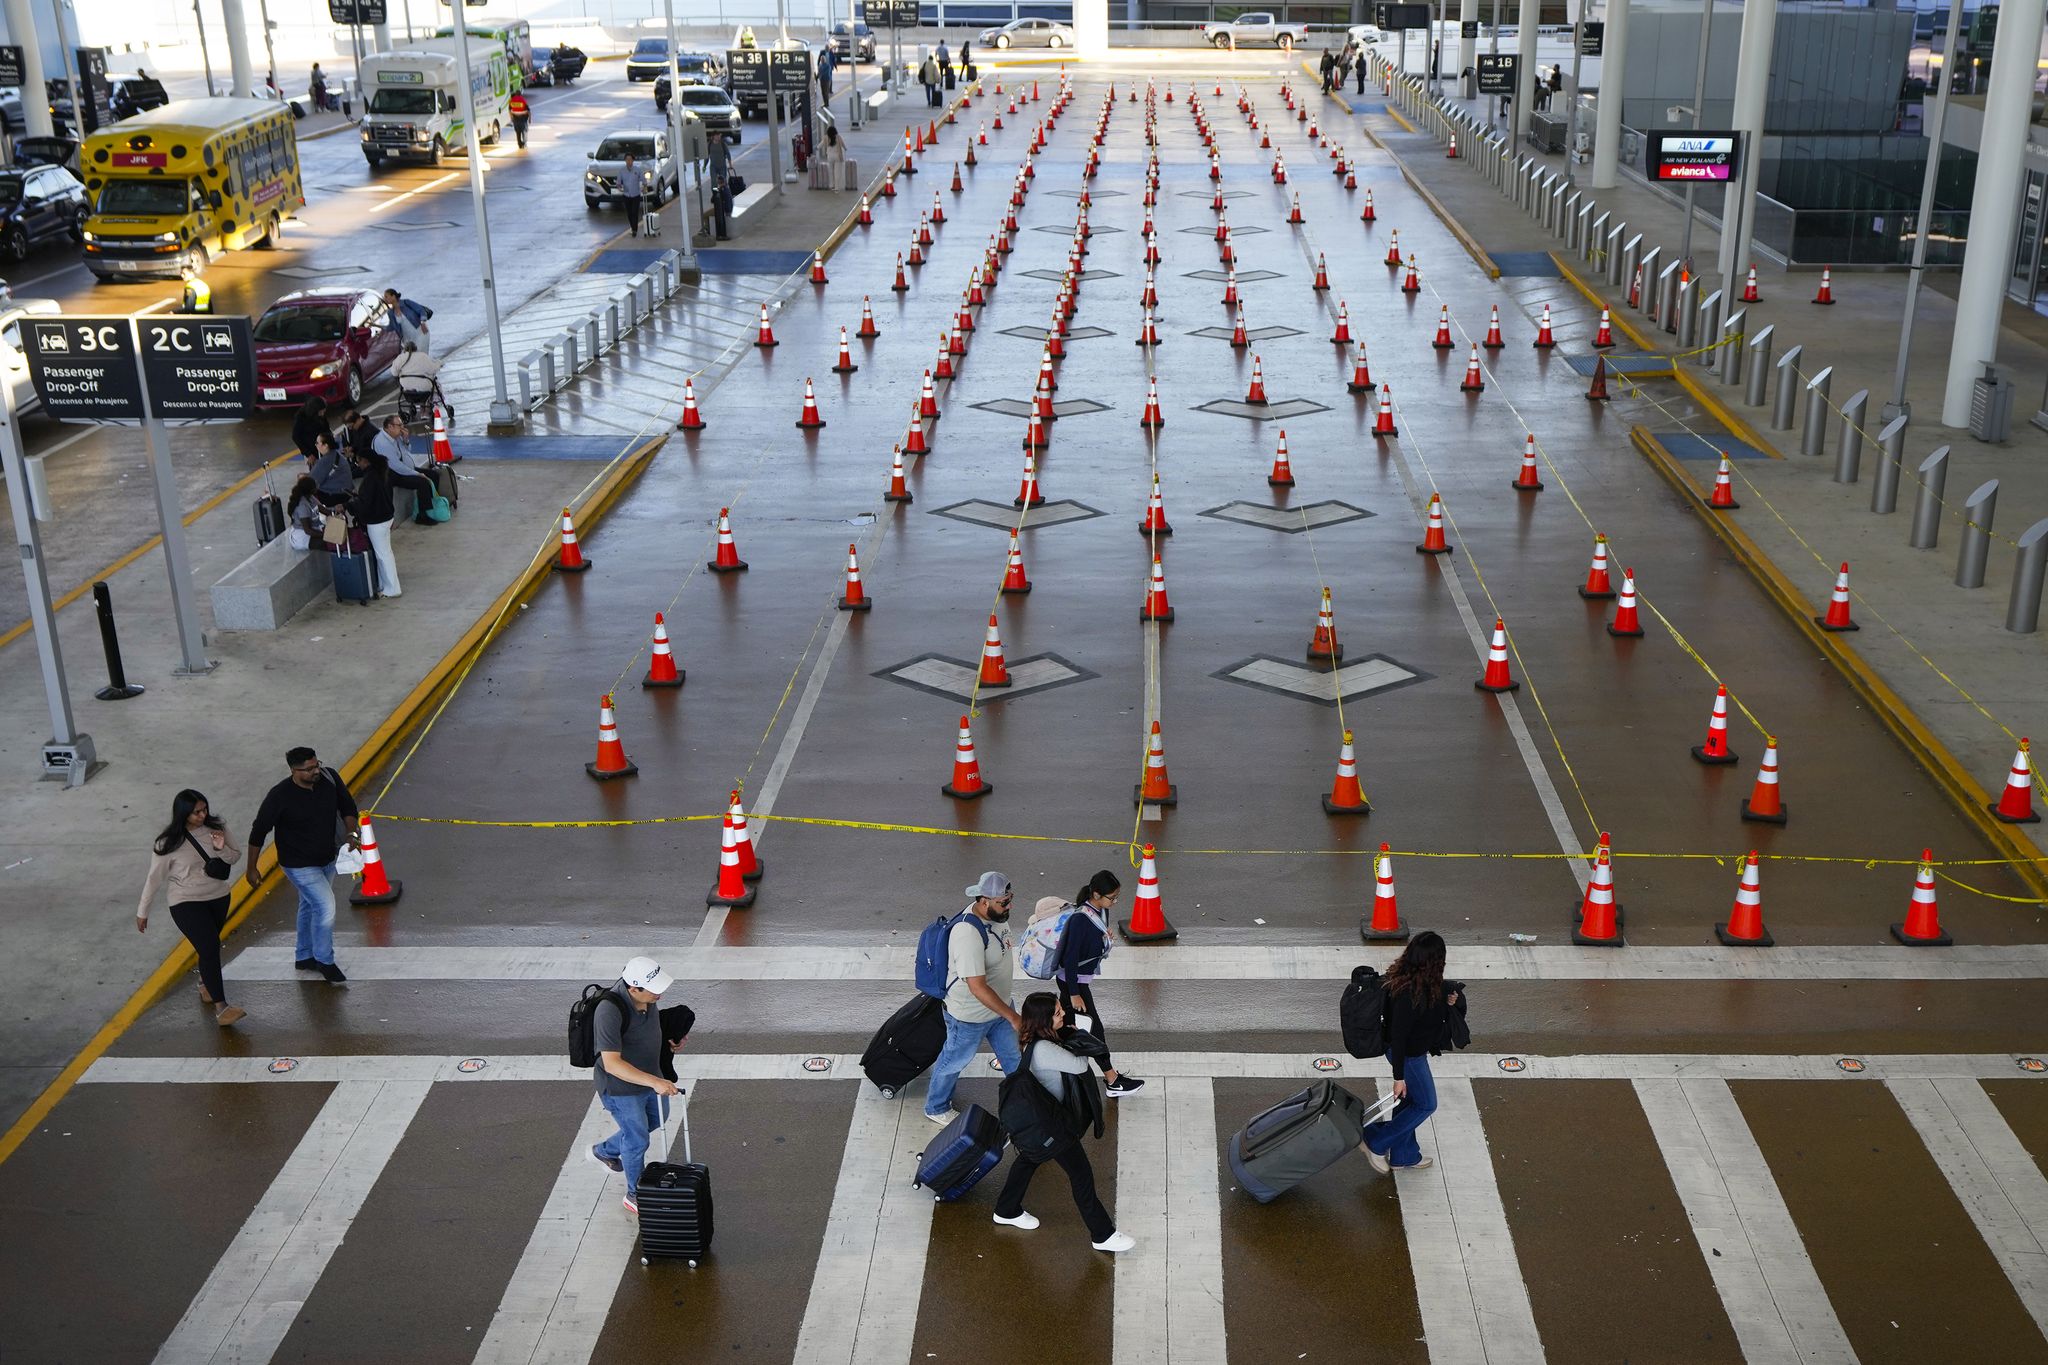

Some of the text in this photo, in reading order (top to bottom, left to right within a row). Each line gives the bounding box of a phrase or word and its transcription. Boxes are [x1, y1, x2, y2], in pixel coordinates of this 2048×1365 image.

[747, 53, 762, 64] 3B
[775, 53, 790, 64] 2B
[1498, 57, 1512, 67] 1B
[1678, 141, 1703, 150] ANA
[130, 155, 148, 164] JFK
[1671, 166, 1705, 176] avianca
[78, 327, 119, 351] 3C
[151, 327, 192, 351] 2C
[43, 367, 105, 380] Passenger
[176, 367, 236, 381] Passenger
[46, 382, 99, 394] Drop-Off
[188, 382, 239, 394] Drop-Off
[49, 397, 83, 405] Descenso
[95, 397, 128, 405] Pasajeros
[209, 401, 242, 409] Pasajeros
